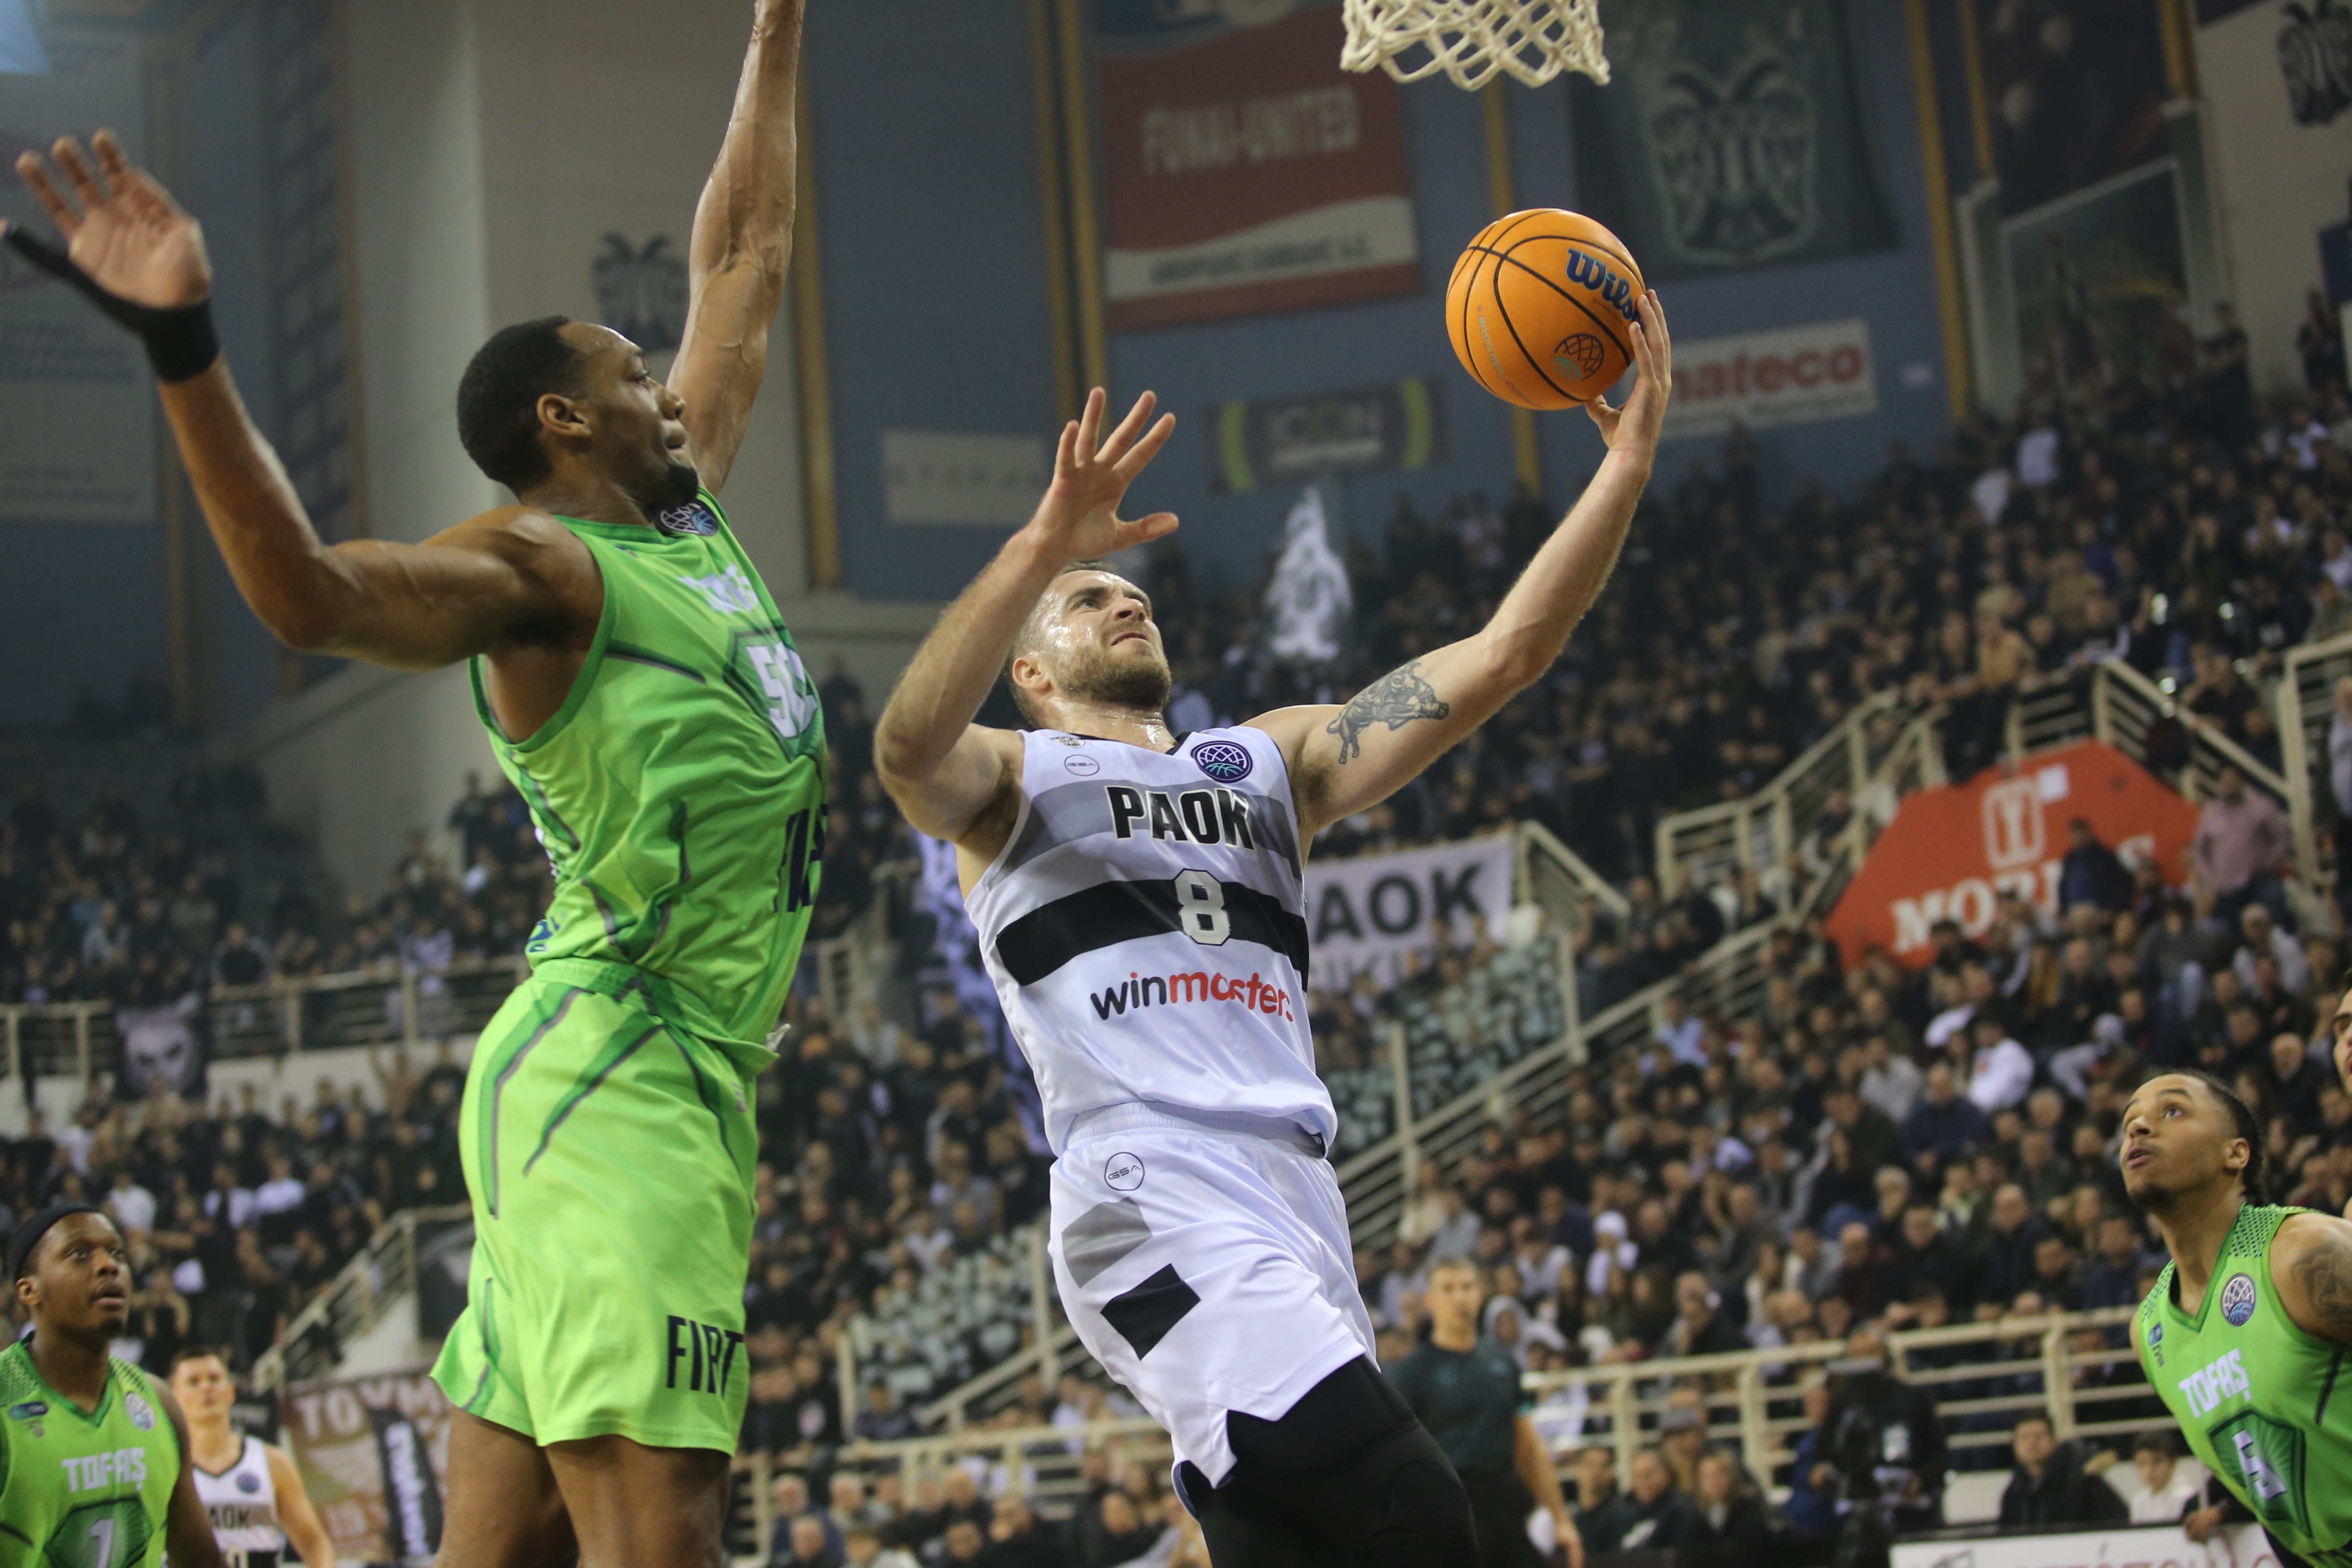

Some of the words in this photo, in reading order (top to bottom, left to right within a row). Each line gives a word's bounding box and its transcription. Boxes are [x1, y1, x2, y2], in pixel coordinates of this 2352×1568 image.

[1567, 248, 1643, 330] Wils
[1104, 785, 1254, 850] PAOK
[1173, 867, 1231, 946] 8
[1317, 863, 1484, 945] AOK
[1108, 1165, 1142, 1180] GSA
[89, 1518, 113, 1568] 1
[209, 1504, 250, 1530] AOK
